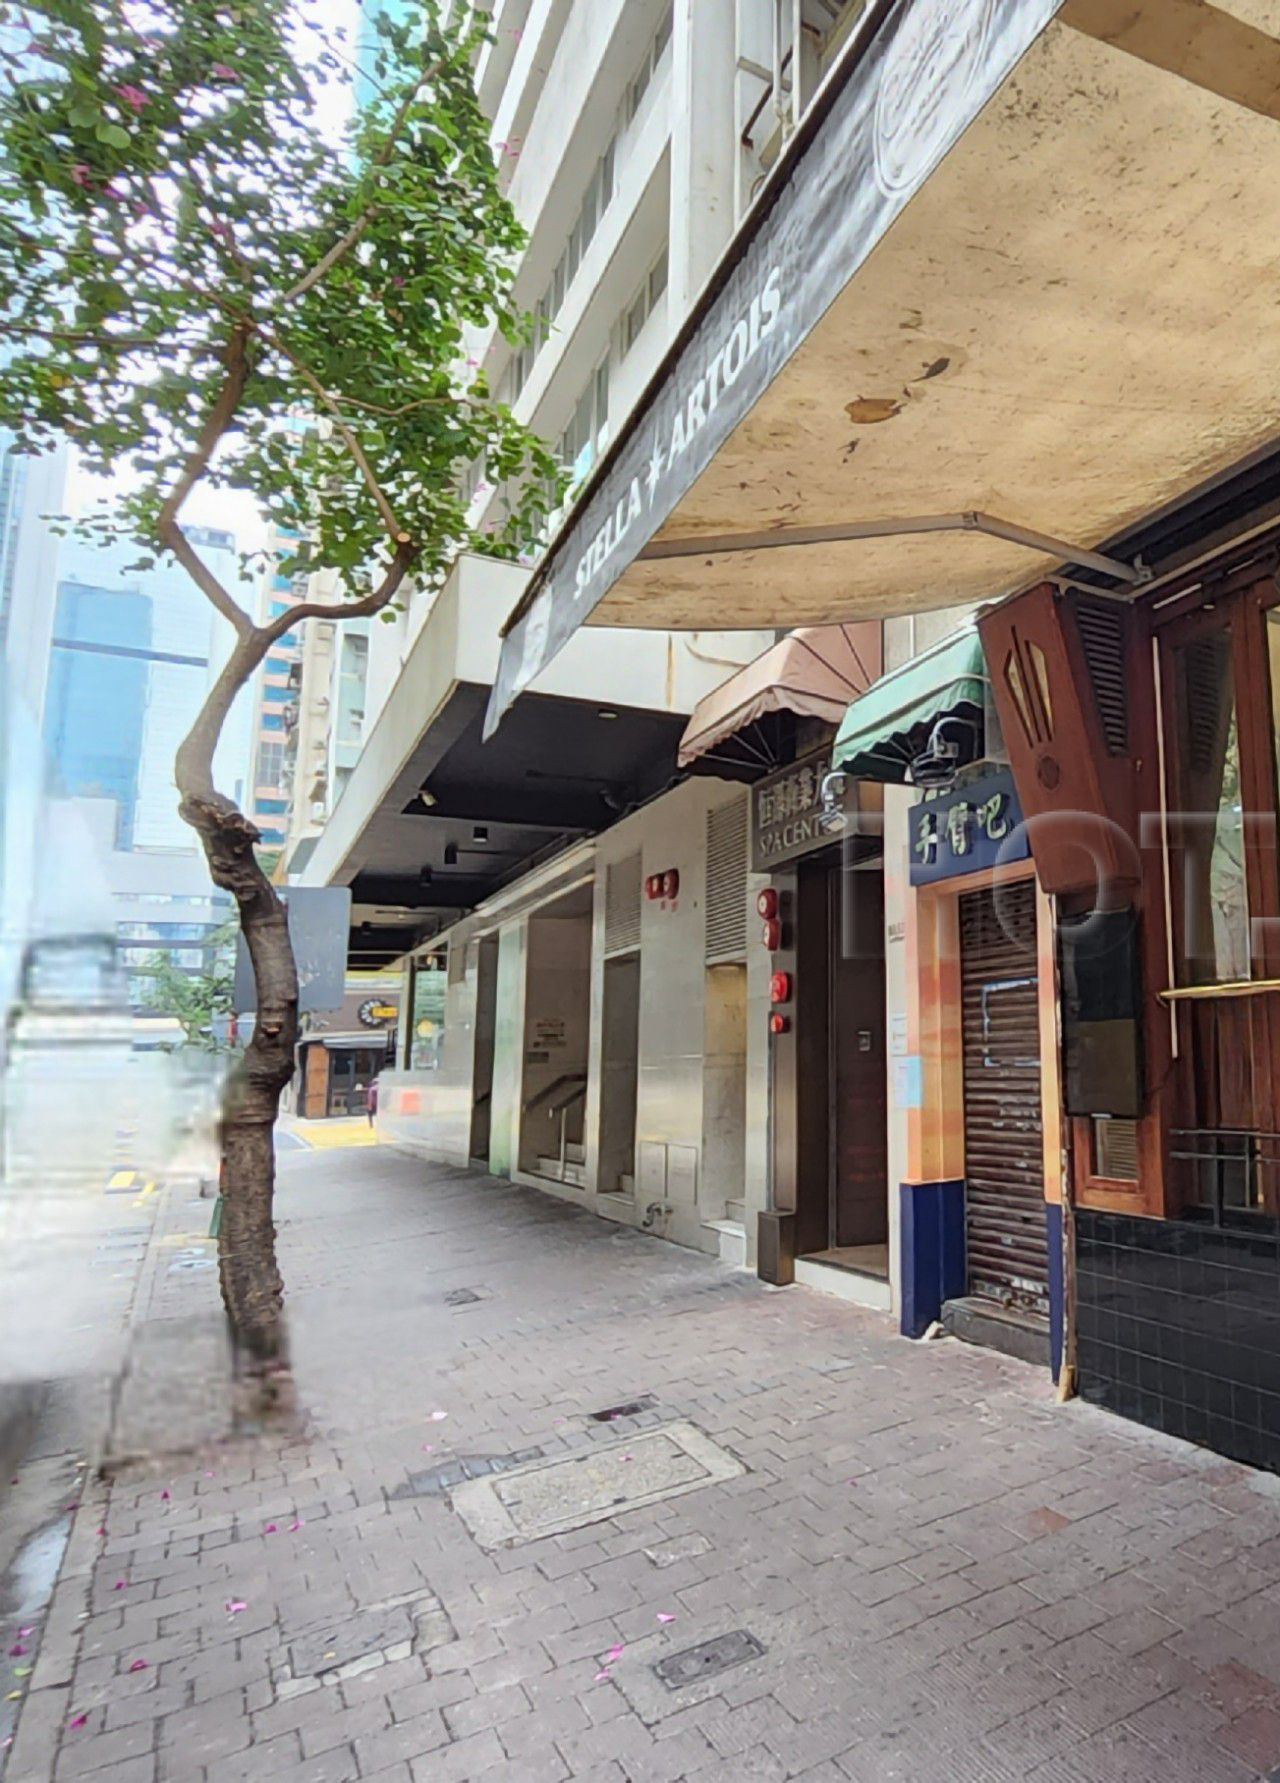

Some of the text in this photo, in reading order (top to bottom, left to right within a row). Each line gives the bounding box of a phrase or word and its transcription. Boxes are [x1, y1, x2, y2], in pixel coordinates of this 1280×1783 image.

[573, 266, 780, 600] STELLA ARTOIS
[783, 803, 843, 848] CENT
